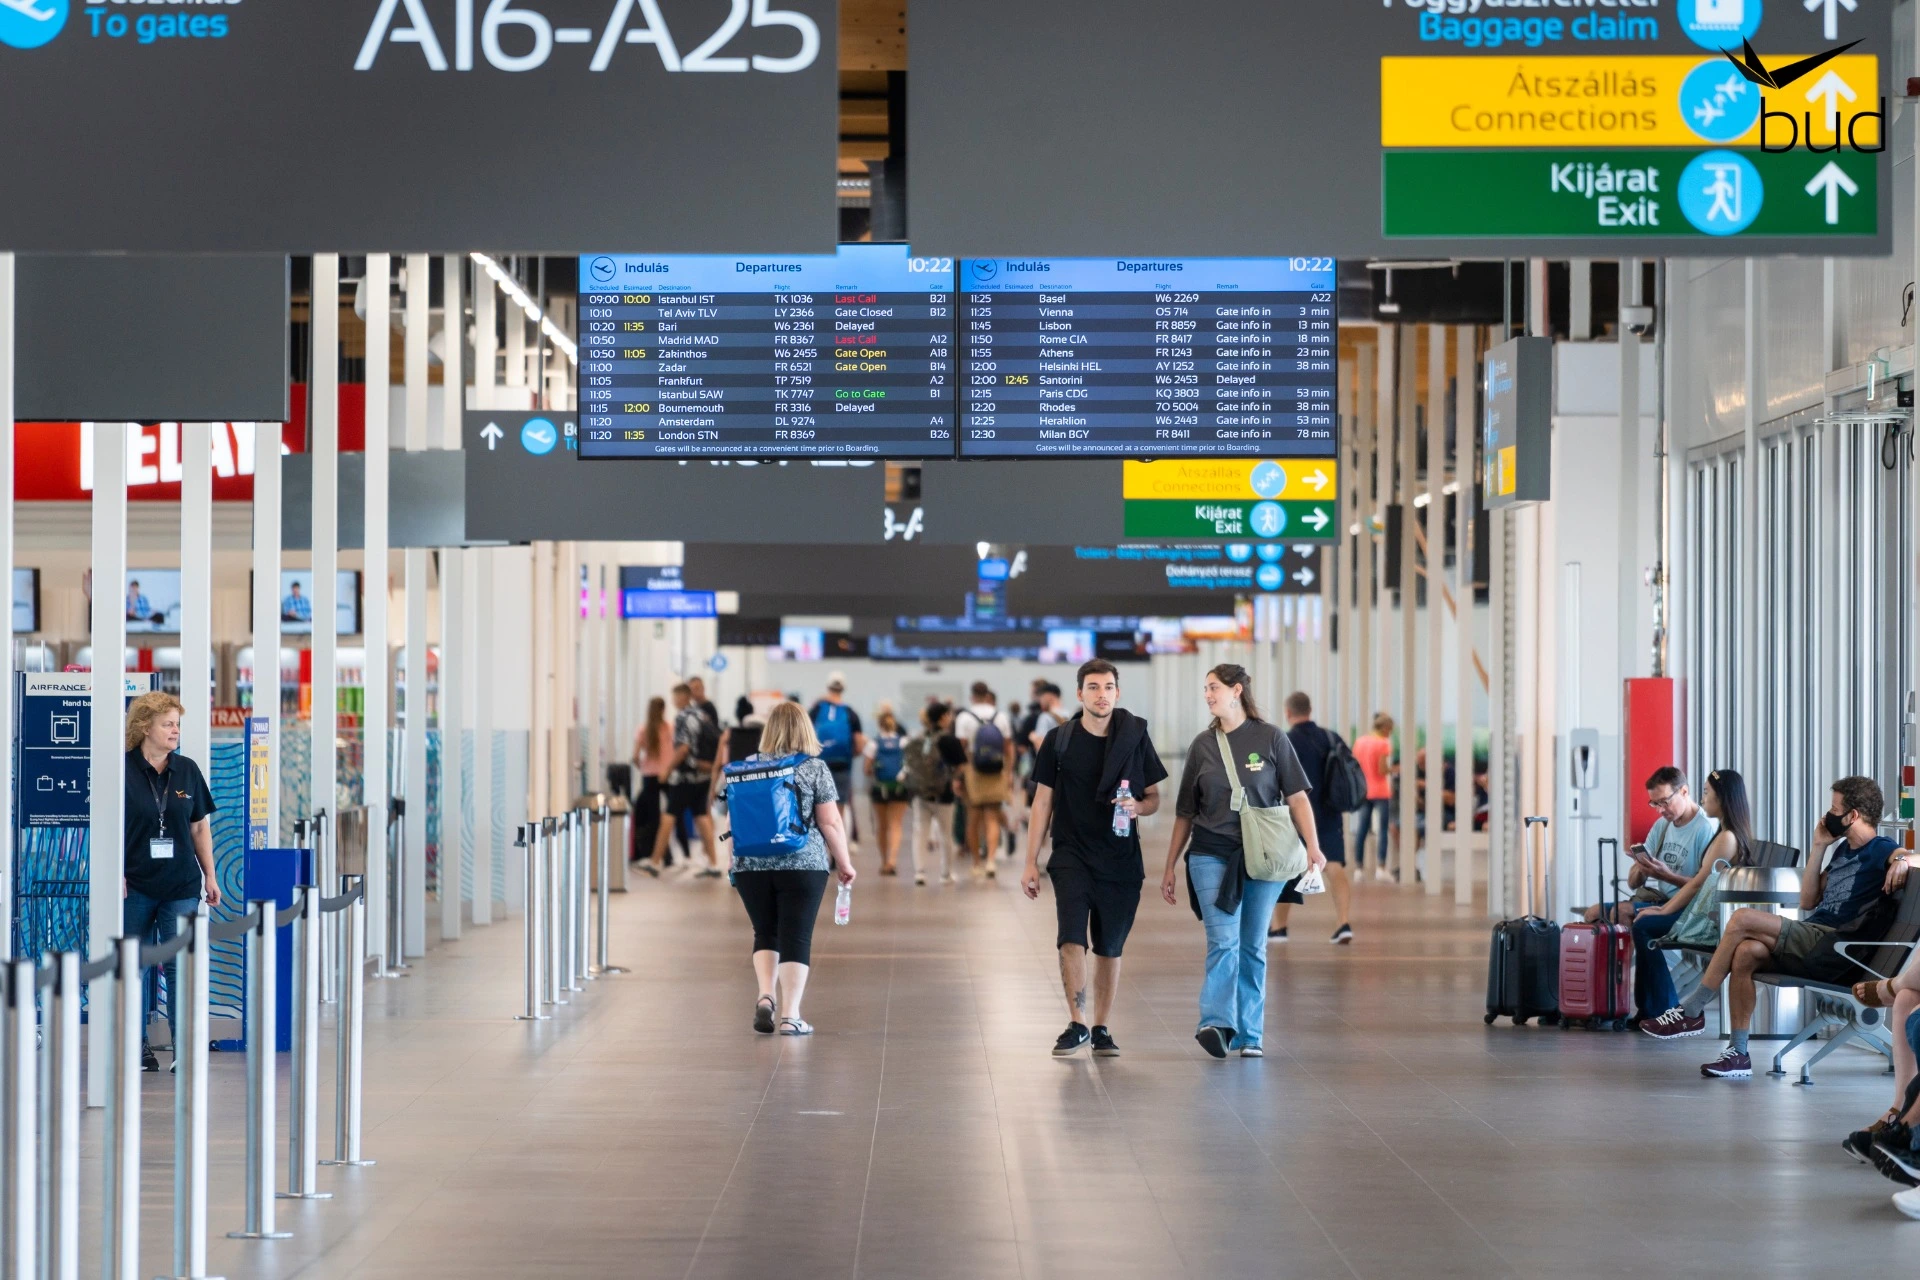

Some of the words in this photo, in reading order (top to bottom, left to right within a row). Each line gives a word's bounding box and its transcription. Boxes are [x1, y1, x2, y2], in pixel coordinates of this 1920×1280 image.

[84, 7, 128, 38] To
[136, 12, 229, 44] gates
[1419, 11, 1564, 48] Baggage
[1571, 10, 1658, 40] claim
[353, 0, 821, 73] A16-A25
[1508, 68, 1658, 99] Átszállás
[1450, 104, 1658, 132] Connections
[1551, 164, 1659, 198] Kijárat
[1599, 198, 1659, 226] Exit
[625, 262, 670, 273] Indulás
[736, 262, 802, 275] Departures
[907, 258, 952, 272] 10:22
[1006, 261, 1050, 272] Indulás
[1116, 261, 1184, 274] Departures
[1288, 258, 1333, 272] 10:22
[589, 295, 620, 304] 09:00
[623, 295, 650, 303] 10:00
[658, 294, 697, 304] Istanbul
[699, 294, 715, 304] IST
[774, 294, 788, 303] TK
[790, 294, 813, 304] 1036
[835, 294, 856, 303] Last
[858, 294, 877, 303] Call
[930, 294, 946, 303] B21
[970, 294, 992, 303] 11:25
[1039, 294, 1066, 303] Basel
[1155, 293, 1172, 303] W6
[1173, 293, 1199, 303] 2269
[1310, 293, 1331, 302] A22
[590, 308, 612, 317] 10:10
[658, 308, 672, 317] Tel
[674, 308, 696, 317] Aviv
[697, 308, 718, 317] TLV
[774, 308, 787, 317] LY
[789, 308, 814, 317] 2366
[834, 308, 857, 316] Gate
[859, 307, 892, 316] Closed
[930, 307, 946, 316] B12
[589, 321, 616, 331] 10:20
[624, 322, 644, 331] 11:35
[658, 322, 677, 332] Bari
[774, 321, 791, 331] W6
[792, 321, 814, 330] 2361
[835, 321, 874, 332] Delayed
[589, 336, 616, 345] 10:50
[658, 335, 692, 345] Madrid
[694, 335, 719, 345] MAD
[774, 335, 788, 344] FR
[789, 335, 814, 344] 8367
[835, 335, 856, 344] Last
[858, 335, 877, 344] Call
[930, 335, 947, 344] A12
[589, 349, 616, 359] 10:50
[624, 349, 646, 358] 11:05
[658, 349, 707, 358] Zakinthos
[774, 348, 791, 358] W6
[792, 348, 818, 358] 2455
[835, 348, 857, 357] Gate
[859, 348, 886, 359] Open
[929, 348, 947, 357] A18
[589, 362, 612, 372] 11:00
[658, 362, 686, 372] Zadar
[774, 362, 788, 371] FR
[790, 362, 812, 371] 6521
[835, 362, 857, 370] Gate
[860, 362, 886, 372] Open
[930, 361, 946, 370] B14
[589, 376, 612, 386] 11:05
[658, 376, 703, 386] Frankfurt
[774, 375, 788, 385] TP
[789, 375, 812, 385] 7519
[929, 375, 944, 385] A2
[971, 375, 997, 385] 12:00
[1005, 375, 1028, 384] 12:45
[1039, 375, 1082, 385] Santorini
[1155, 374, 1172, 384] W6
[1173, 374, 1198, 384] 2453
[1216, 374, 1256, 386] Delayed
[589, 390, 612, 399] 11:05
[658, 390, 697, 399] Istanbul
[699, 390, 724, 399] SAW
[774, 389, 788, 398] TK
[790, 389, 814, 398] 7747
[835, 389, 848, 397] Go
[863, 389, 885, 397] Gate
[930, 389, 940, 398] B1
[589, 403, 608, 413] 11:15
[624, 403, 650, 412] 12:00
[658, 403, 724, 413] Bournemouth
[775, 403, 788, 412] FR
[790, 402, 812, 412] 3316
[835, 402, 874, 413] Delayed
[589, 417, 612, 426] 11:20
[658, 417, 714, 426] Amsterdam
[775, 416, 789, 425] DL
[790, 416, 815, 426] 9274
[929, 416, 944, 425] A4
[590, 430, 612, 440] 11:20
[624, 430, 644, 440] 11:35
[658, 430, 695, 440] London
[697, 430, 718, 440] STN
[775, 430, 788, 439] FR
[790, 430, 816, 439] 8369
[930, 429, 950, 439] B26
[654, 445, 676, 453] Gates
[818, 444, 834, 452] prior
[845, 444, 880, 453] Boarding.
[1152, 480, 1242, 494] Connections
[1195, 506, 1242, 521] Kijárat
[1215, 520, 1242, 534] Exit
